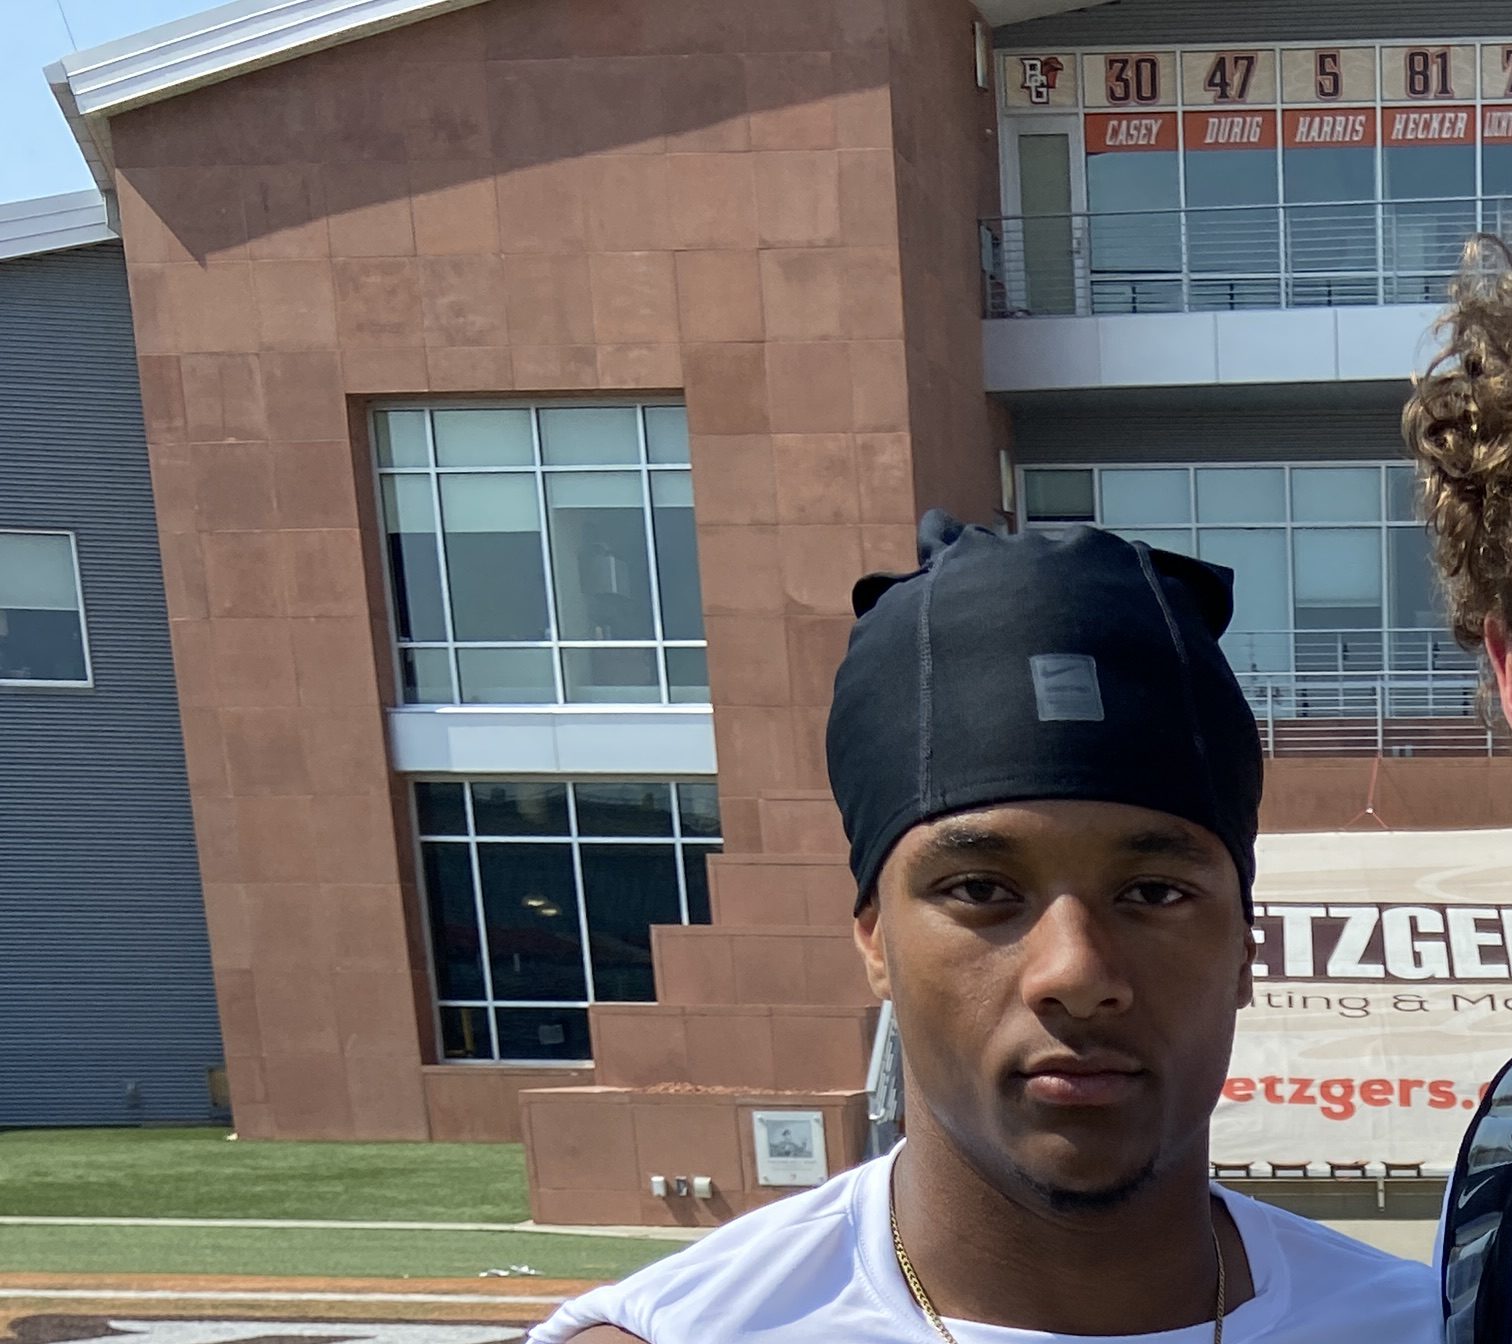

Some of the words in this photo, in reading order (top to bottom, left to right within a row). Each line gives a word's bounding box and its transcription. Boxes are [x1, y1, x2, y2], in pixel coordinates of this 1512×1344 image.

[1106, 53, 1160, 104] 30
[1205, 51, 1258, 101] 47
[1315, 49, 1343, 100] 5
[1405, 46, 1455, 98] 81
[1105, 118, 1162, 145] CASEY
[1204, 116, 1263, 144] DURIG
[1295, 114, 1367, 143] HARRIS
[1391, 112, 1467, 140] HECKER
[1250, 991, 1371, 1019] ting
[1392, 994, 1430, 1012] &
[1221, 1074, 1492, 1121] etzgers.
